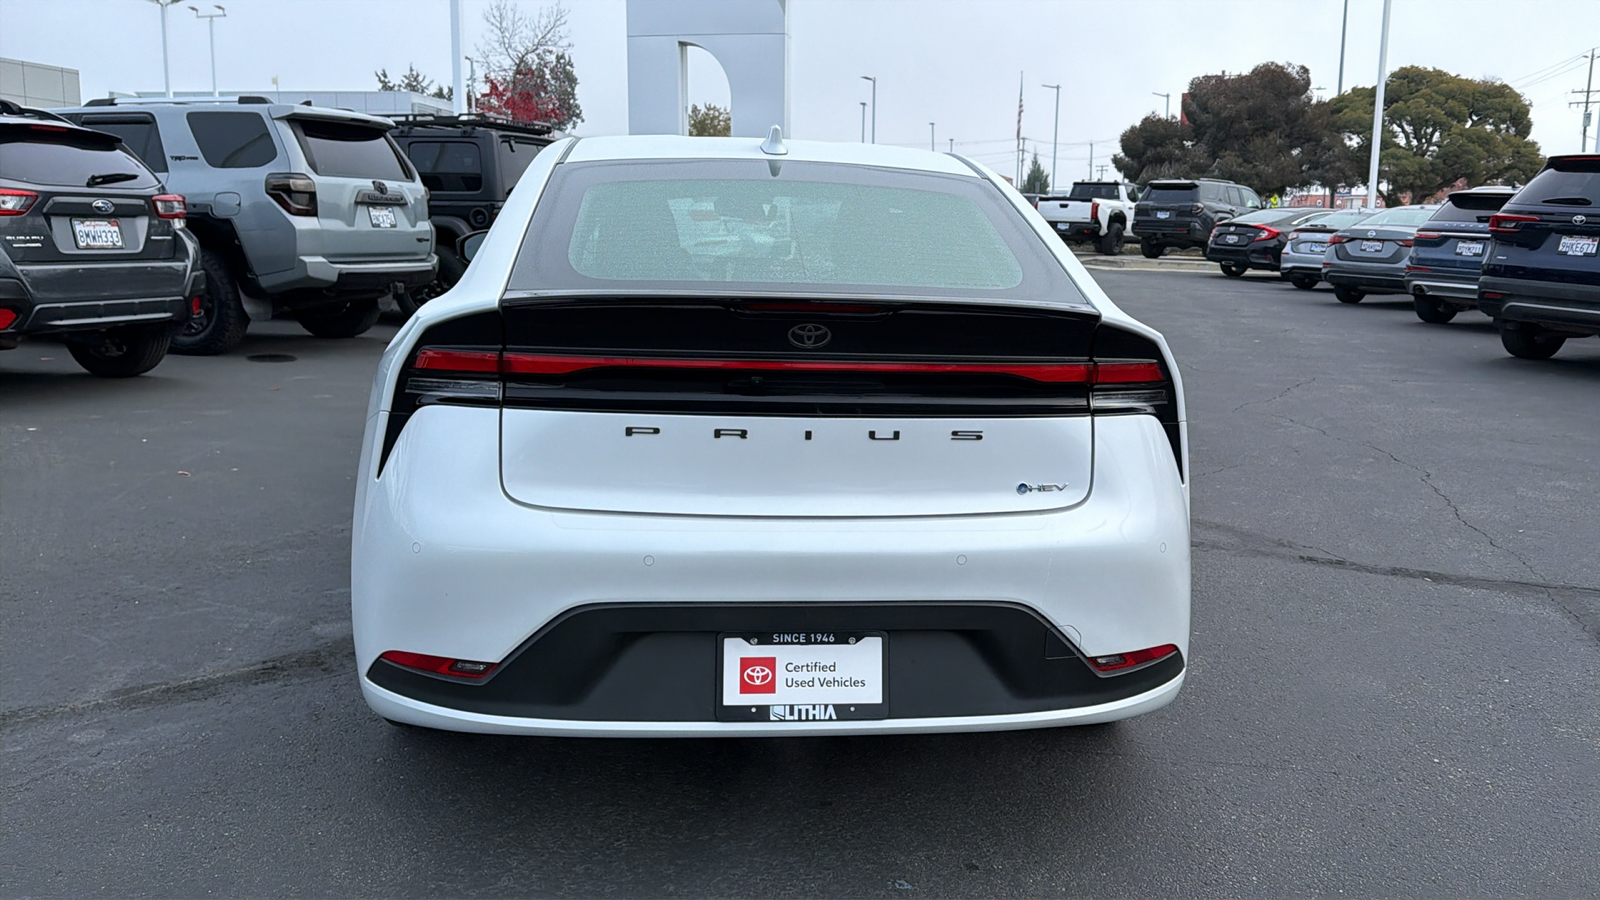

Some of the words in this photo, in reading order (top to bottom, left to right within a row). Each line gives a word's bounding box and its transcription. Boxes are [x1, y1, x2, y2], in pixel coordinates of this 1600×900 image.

[78, 229, 120, 243] 8MWH333
[1561, 241, 1596, 253] 9HKE677
[625, 426, 984, 441] PRIUS
[1028, 482, 1070, 492] HEV
[773, 633, 806, 643] SINCE
[810, 633, 835, 643] 1946
[785, 661, 836, 673] Certified
[785, 677, 815, 688] Used
[818, 676, 866, 687] Vehicles
[784, 704, 837, 720] LITHIA
